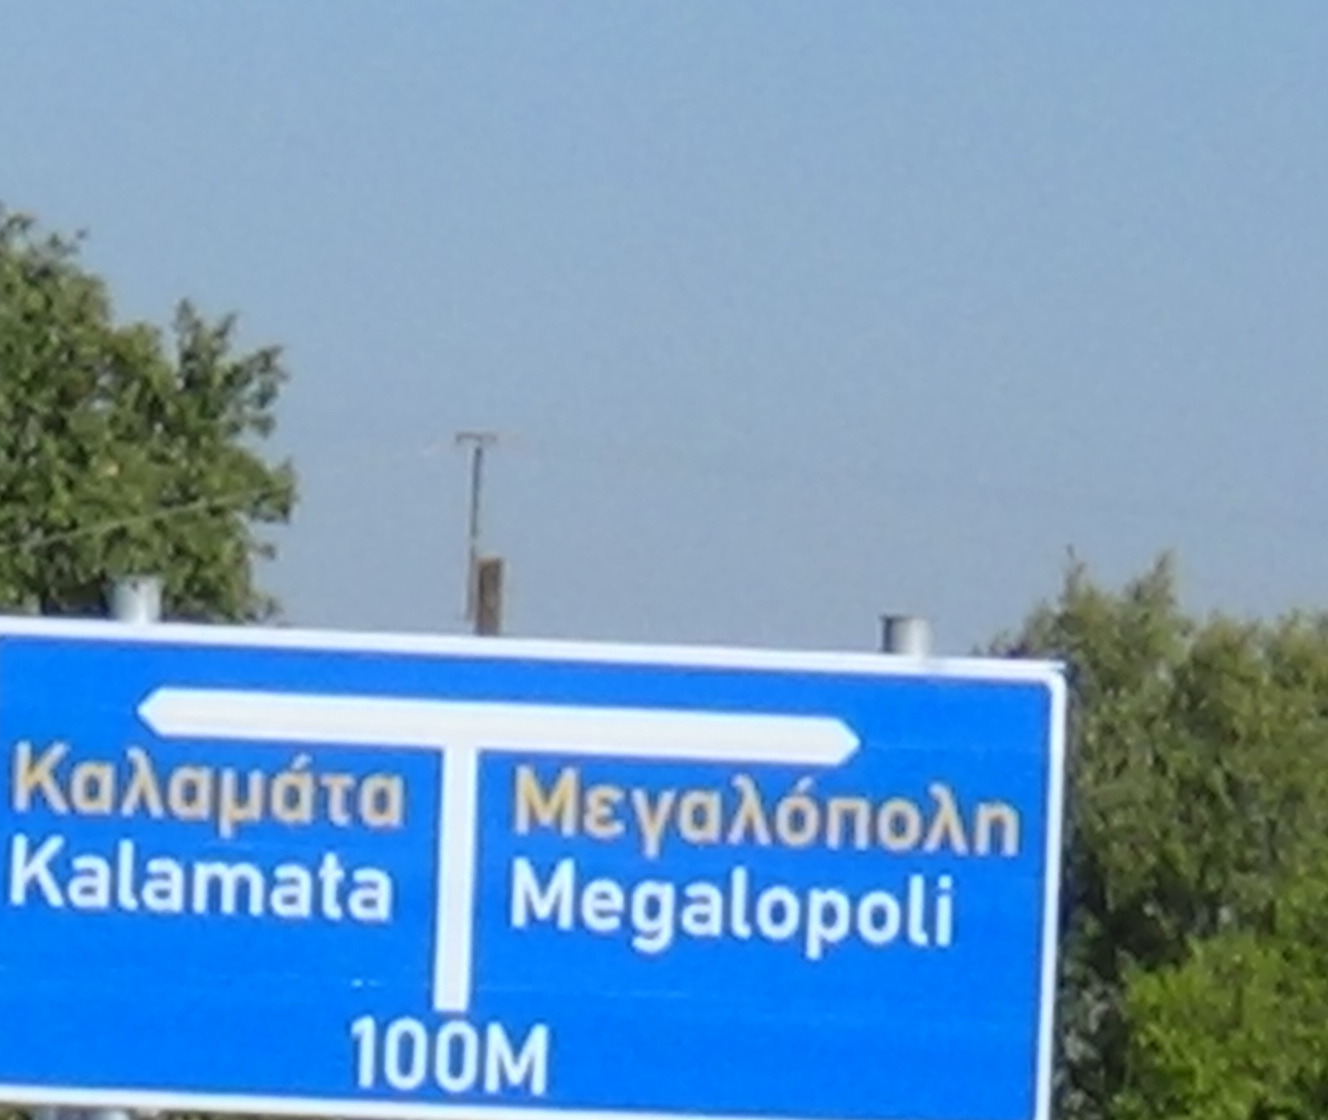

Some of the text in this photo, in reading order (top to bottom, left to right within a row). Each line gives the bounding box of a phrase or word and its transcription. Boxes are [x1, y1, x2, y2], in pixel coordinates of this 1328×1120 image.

[13, 742, 405, 837] Καλαμάτα
[514, 763, 1020, 860] Μεγαλόπολη
[10, 834, 393, 922] Kalamata
[511, 860, 953, 960] Megalopoli
[351, 1016, 549, 1097] 100M
